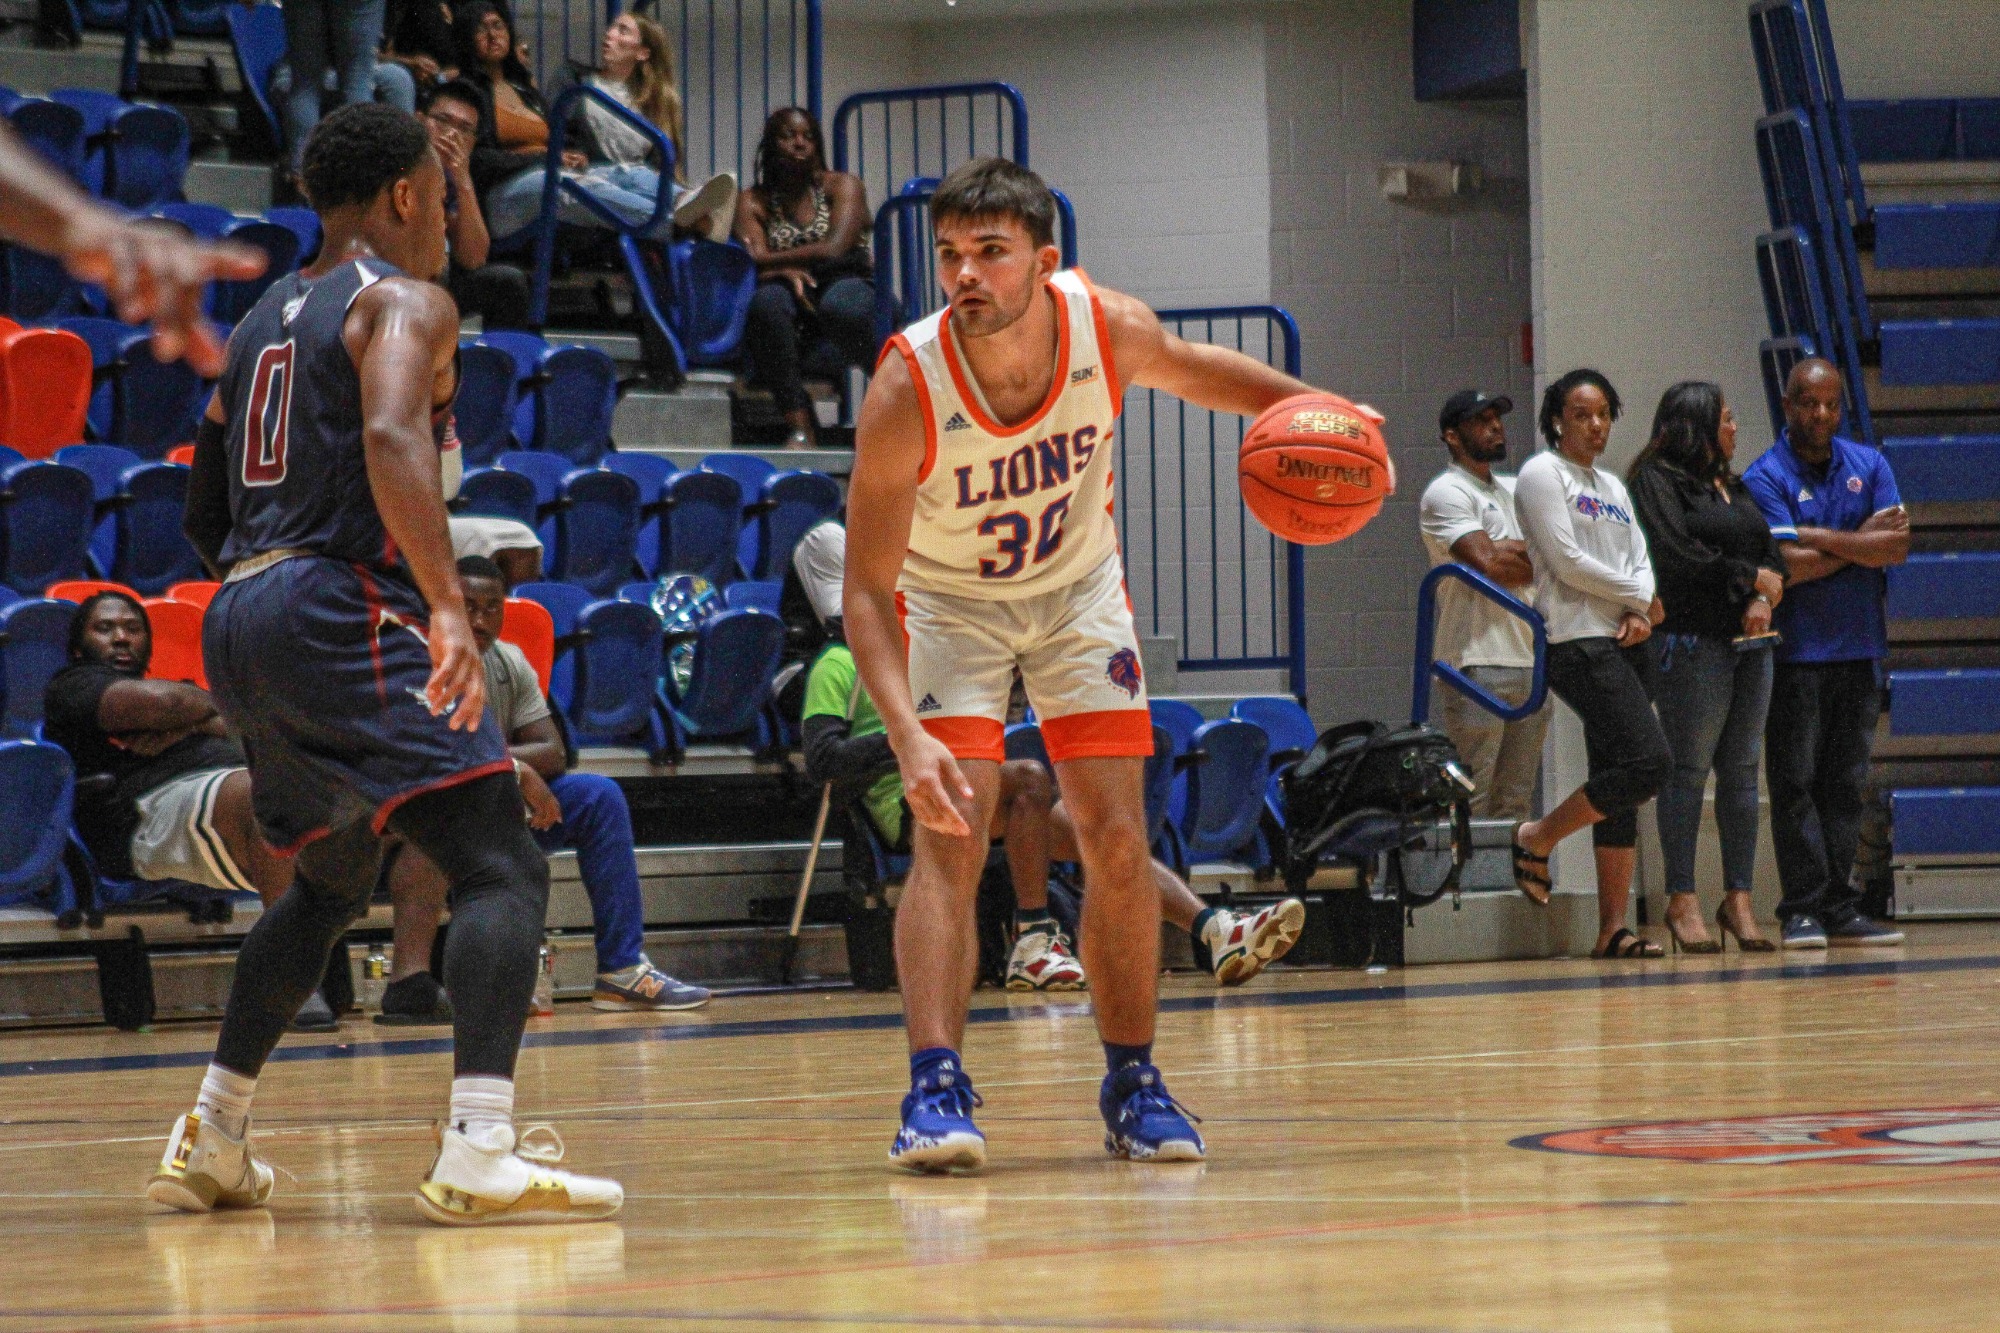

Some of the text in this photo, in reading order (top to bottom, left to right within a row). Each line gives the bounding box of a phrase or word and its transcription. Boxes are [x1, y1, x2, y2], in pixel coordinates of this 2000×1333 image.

[242, 338, 295, 488] 0
[954, 424, 1098, 509] LIONS
[1276, 453, 1375, 489] SPALDING
